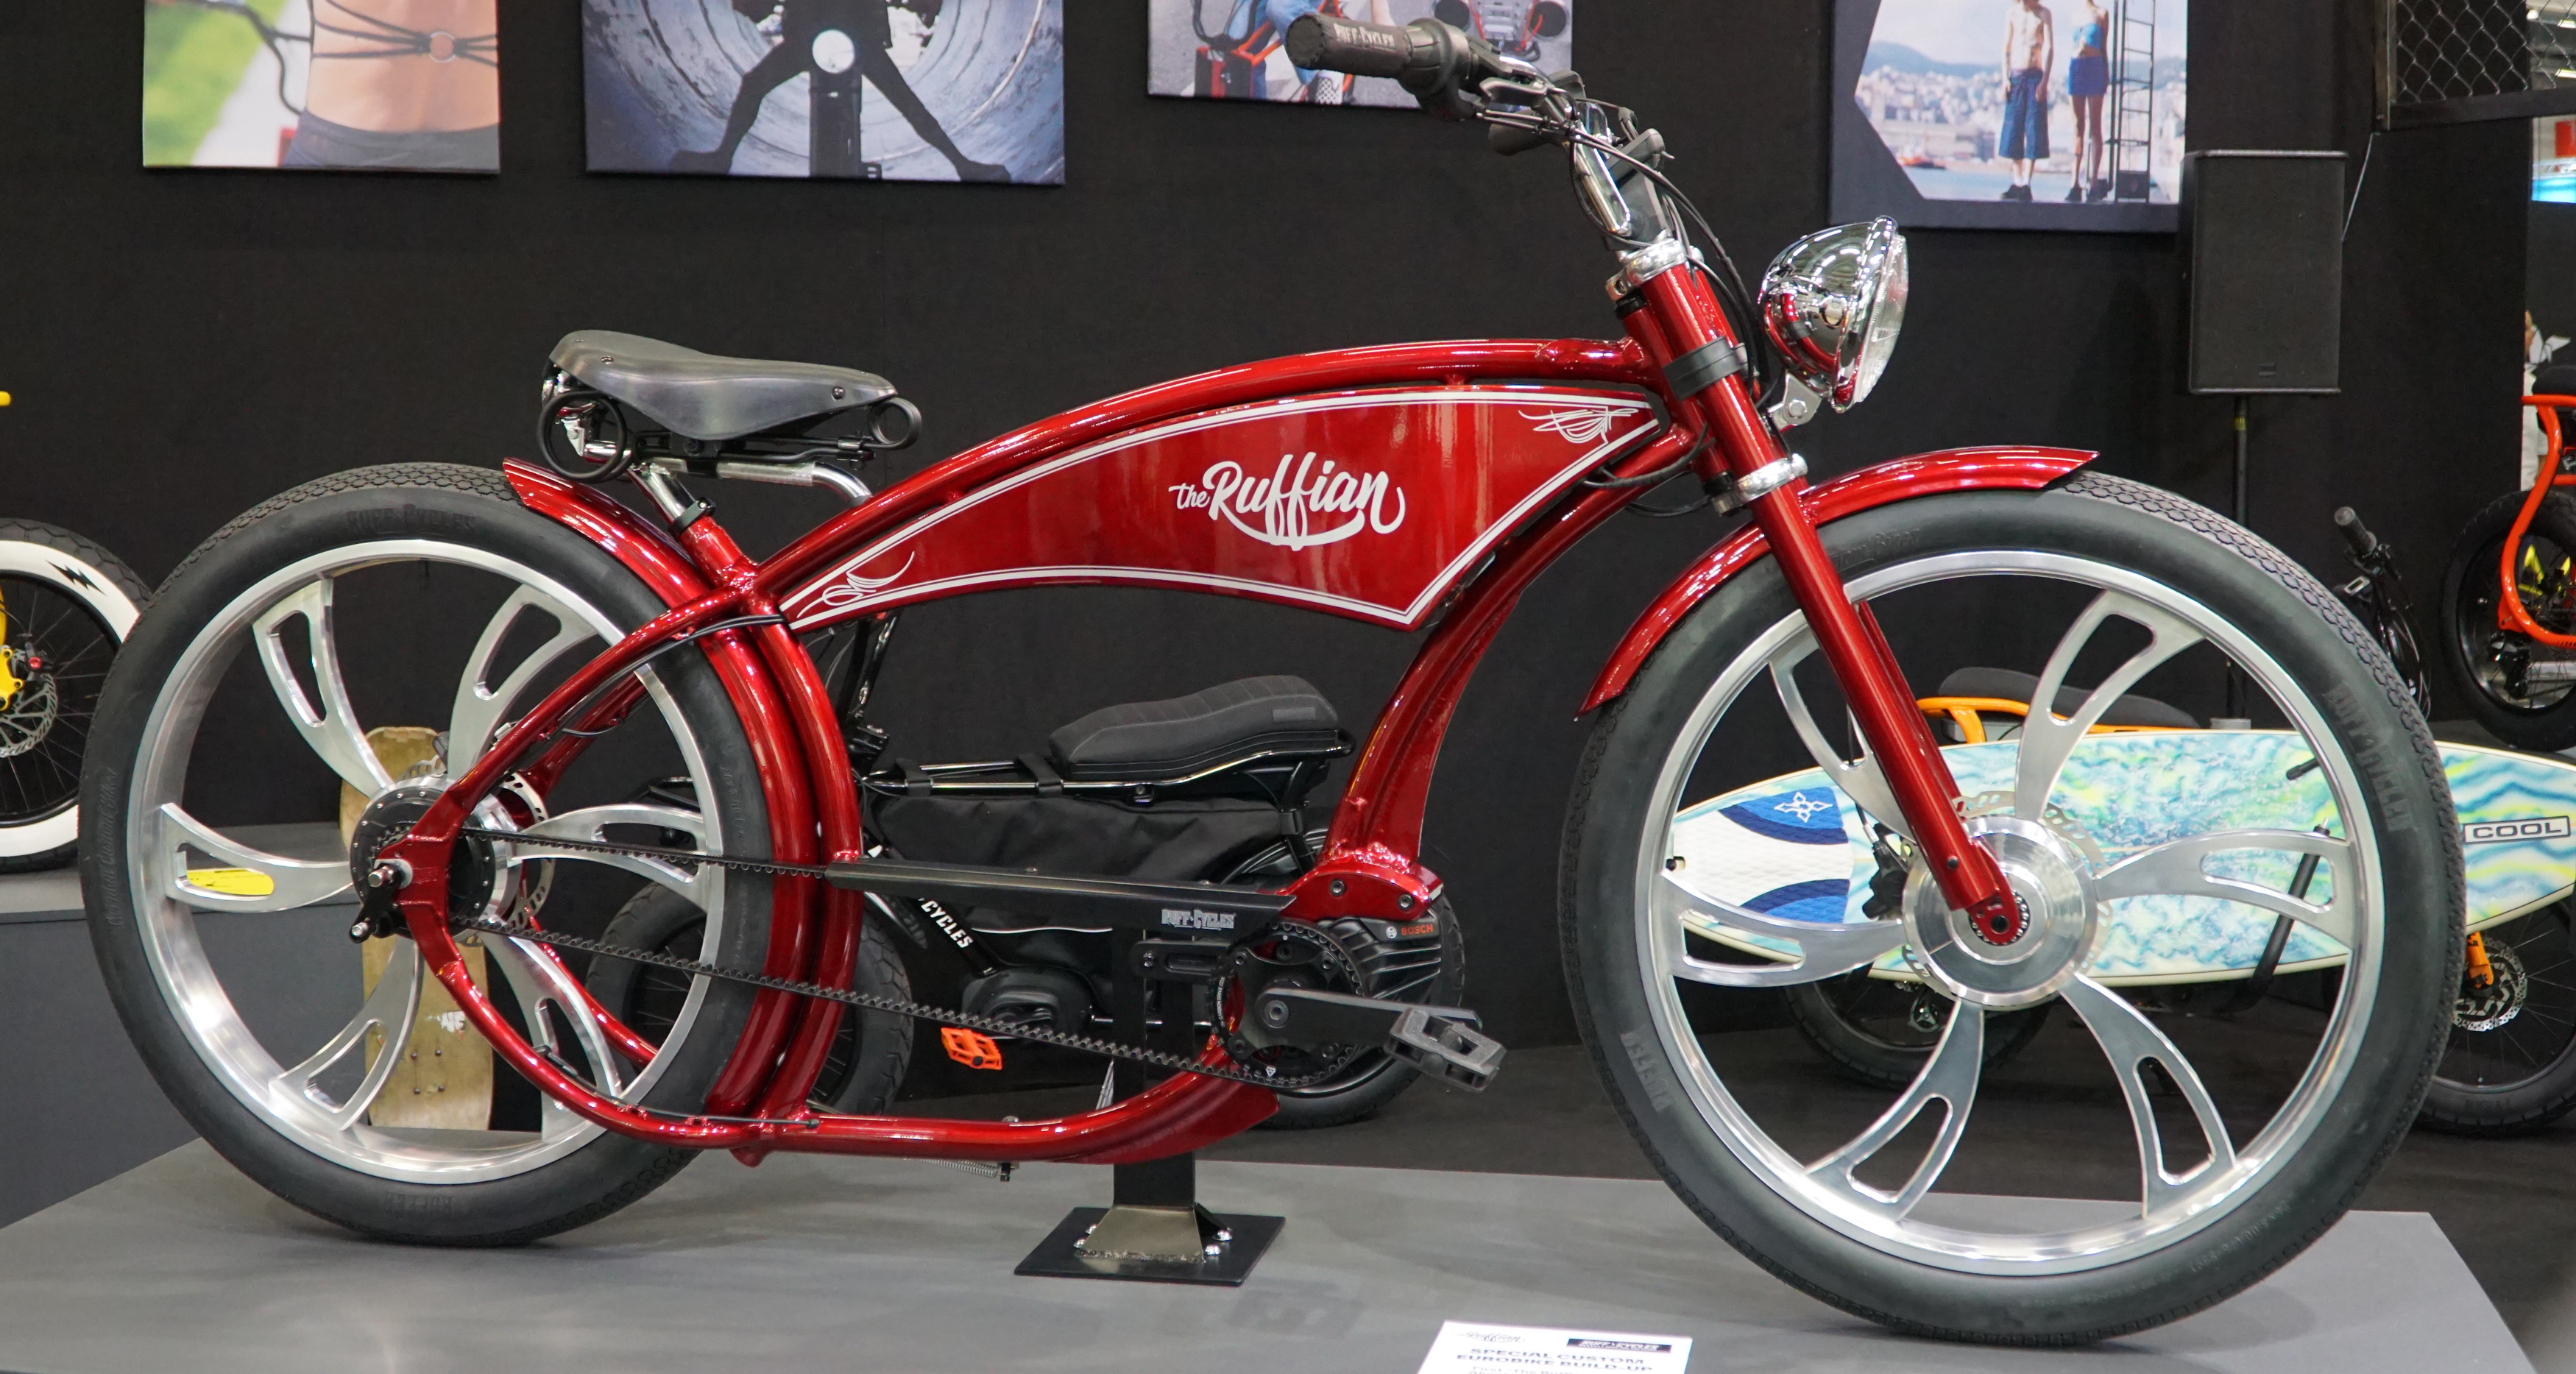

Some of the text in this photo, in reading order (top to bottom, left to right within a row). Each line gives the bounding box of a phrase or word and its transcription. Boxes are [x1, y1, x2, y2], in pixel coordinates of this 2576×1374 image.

[1168, 451, 1406, 551] the Ruffian
[2472, 822, 2562, 840] COOL
[921, 900, 974, 948] CYCLES
[1401, 924, 1434, 936] BOSCH
[1457, 1355, 1554, 1366] EUROBIKE
[1560, 1361, 1653, 1372] BUILD-UP
[1471, 1348, 1644, 1364] SPECIAL CUSTOM
